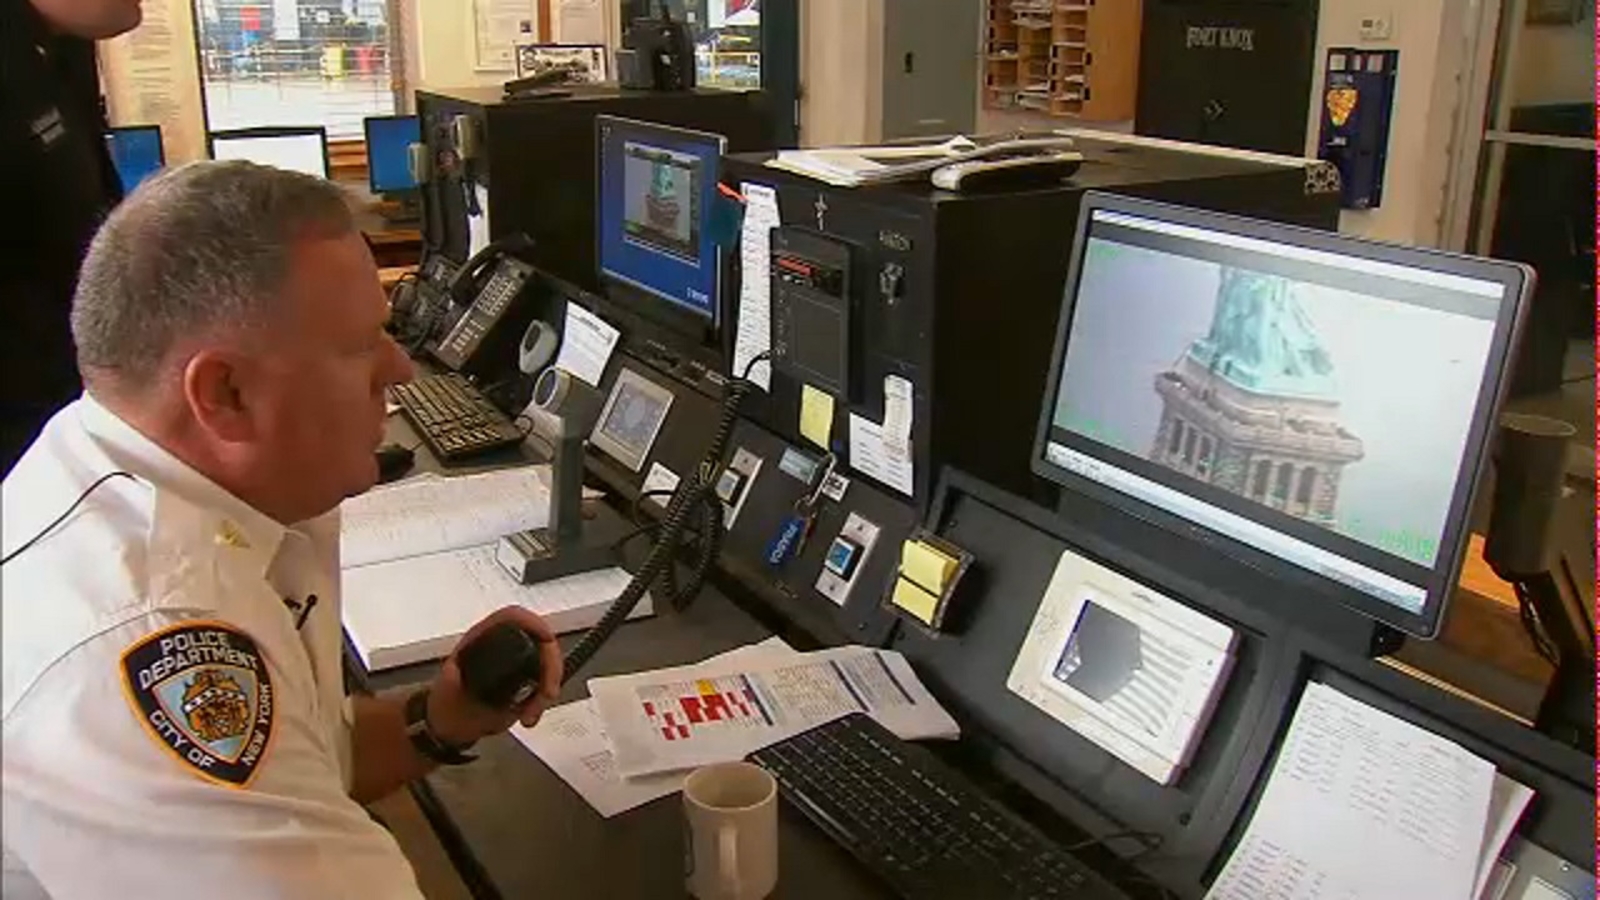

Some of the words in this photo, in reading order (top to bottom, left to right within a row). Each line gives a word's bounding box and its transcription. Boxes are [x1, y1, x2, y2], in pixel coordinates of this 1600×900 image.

[1187, 27, 1218, 48] FORT
[160, 631, 230, 655] POLICE
[138, 646, 259, 690] DEPARTMENT
[149, 709, 188, 748] CITY
[187, 748, 217, 769] OF
[241, 730, 267, 766] NEW
[258, 683, 271, 725] YORK
